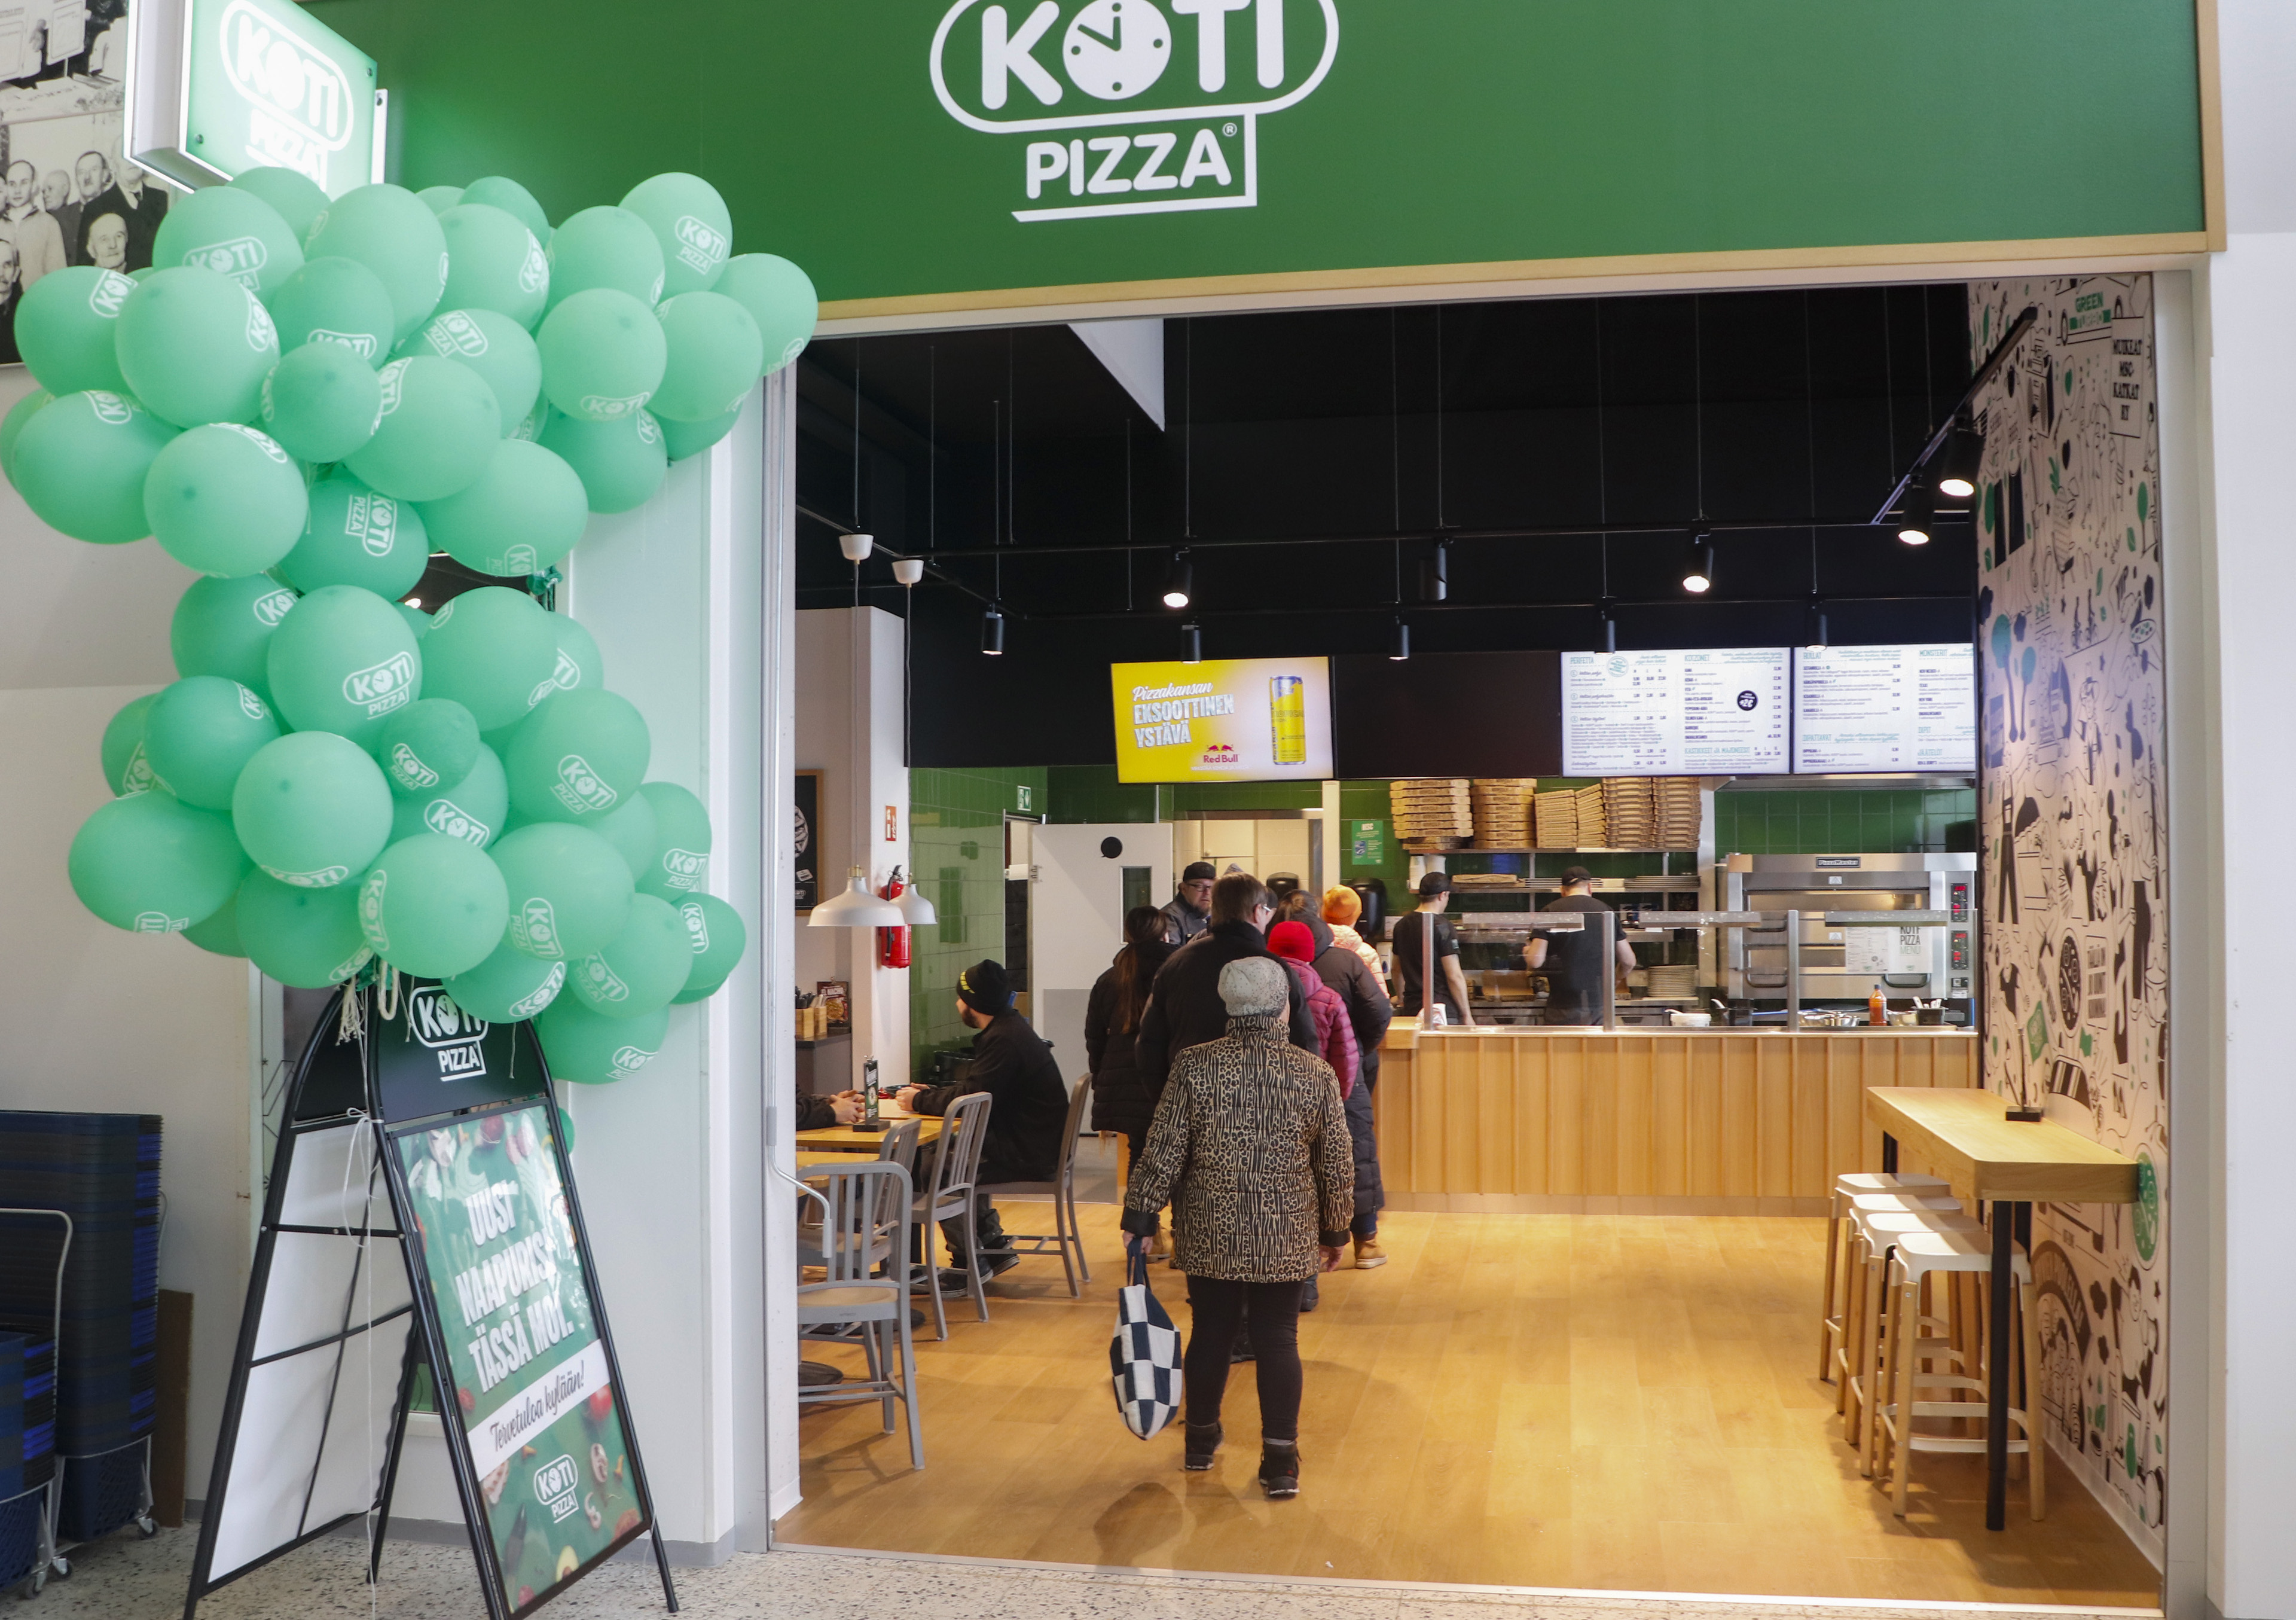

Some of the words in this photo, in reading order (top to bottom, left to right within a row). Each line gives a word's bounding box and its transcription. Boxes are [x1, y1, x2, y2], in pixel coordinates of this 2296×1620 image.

[982, 0, 1284, 109] KOTI
[237, 14, 339, 138] KOTI
[680, 246, 709, 269] PIZZA
[682, 221, 724, 261] KOTI
[350, 496, 366, 530] PIZZA
[367, 495, 393, 548] KOTI
[352, 657, 410, 700] KOTI
[1132, 682, 1214, 701] Pizzakansan
[368, 691, 407, 715] PIZZA
[1134, 694, 1235, 725] EKSOOTTINEN
[1134, 720, 1192, 748] YSTÄVÄ
[395, 748, 435, 785] KOTI
[1204, 755, 1220, 763] Red
[1222, 754, 1238, 762] Bull
[563, 761, 612, 807] KOTI
[430, 804, 486, 845] KOTI
[365, 880, 386, 942] KOTI
[683, 907, 706, 948] KOTI
[526, 908, 559, 956] KOTI
[1900, 935, 1921, 945] PIZZA
[517, 968, 562, 1014] KOTI
[437, 1046, 480, 1072] PIZZA
[468, 1302, 533, 1394] TÄSSÄ
[490, 1396, 545, 1452] Tervetuloa
[544, 1360, 585, 1416] kylään!
[538, 1460, 574, 1499] KOTI
[551, 1497, 576, 1518] PIZZA
